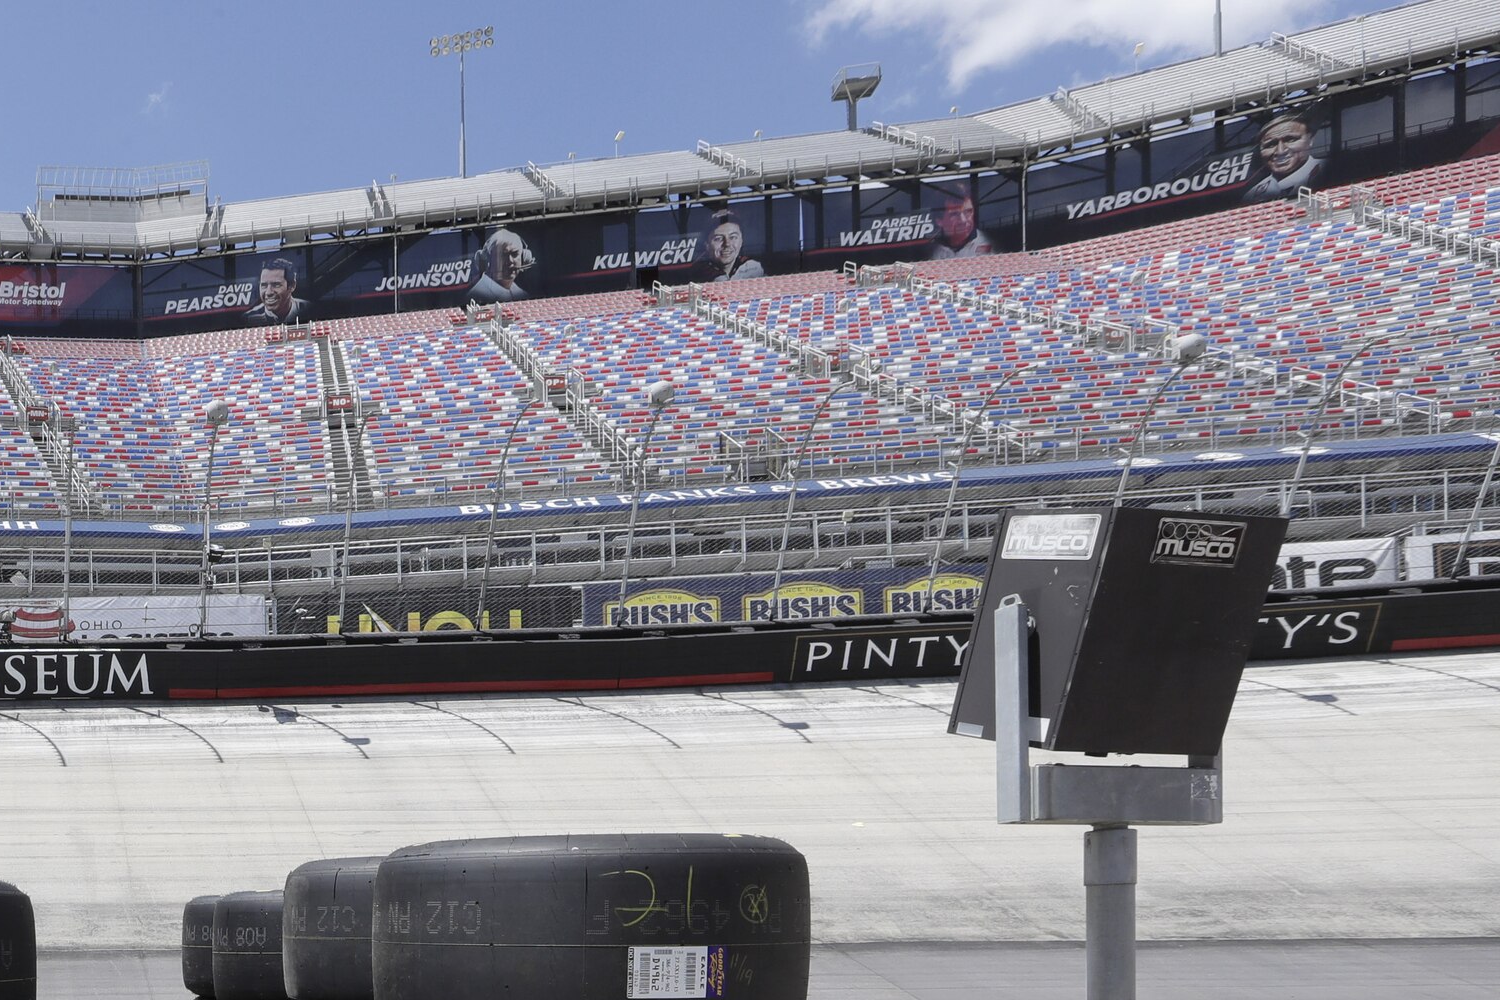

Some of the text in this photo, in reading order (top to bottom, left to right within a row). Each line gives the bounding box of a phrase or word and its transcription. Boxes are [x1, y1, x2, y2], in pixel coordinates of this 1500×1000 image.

[1207, 151, 1253, 173] CALE
[1065, 163, 1250, 221] YARBOROUGH
[871, 212, 933, 230] DARRELL
[661, 237, 697, 251] ALAN
[840, 223, 935, 247] WALTRIP
[427, 259, 472, 273] JUNIOR
[218, 283, 252, 296] DAVID
[375, 269, 471, 293] JOHNSON
[22, 298, 63, 308] Speedway
[164, 292, 251, 314] PEARSON
[459, 494, 601, 515] BUSCH
[817, 469, 955, 491] BREWS
[754, 594, 857, 620] BUSH'S
[891, 588, 981, 613] BUSH'
[79, 619, 123, 631] OHIO
[610, 601, 714, 626] BUSH'S
[806, 635, 972, 672] PINTY
[651, 958, 660, 991] D4962
